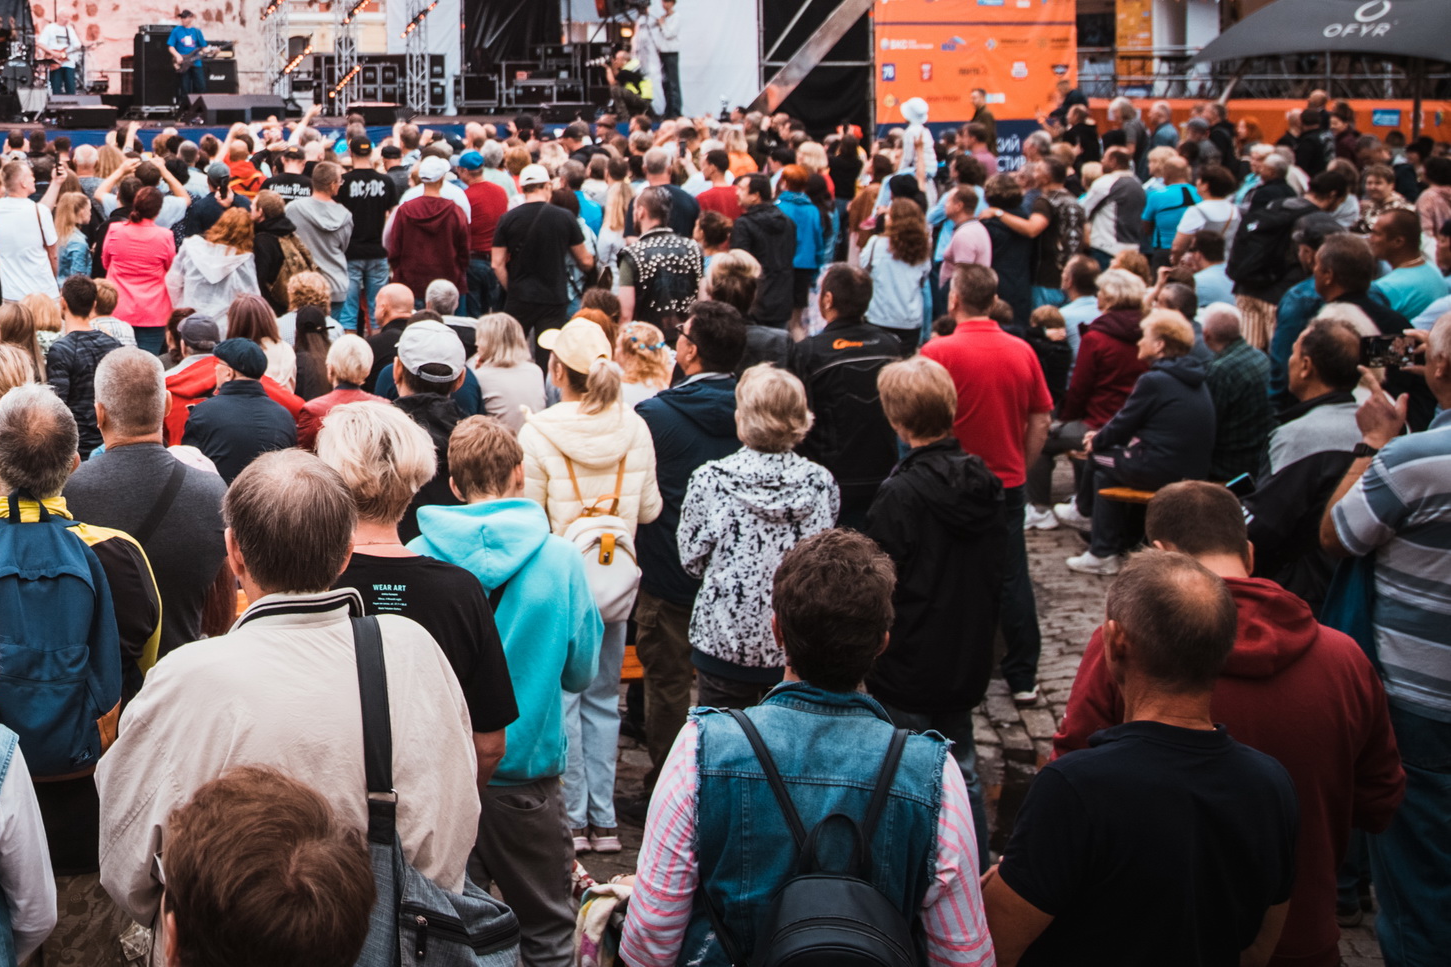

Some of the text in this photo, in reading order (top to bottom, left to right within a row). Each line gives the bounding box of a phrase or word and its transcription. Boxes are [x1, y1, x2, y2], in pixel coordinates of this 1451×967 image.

[1323, 22, 1391, 38] OFYR
[269, 184, 311, 196] Linkin Park
